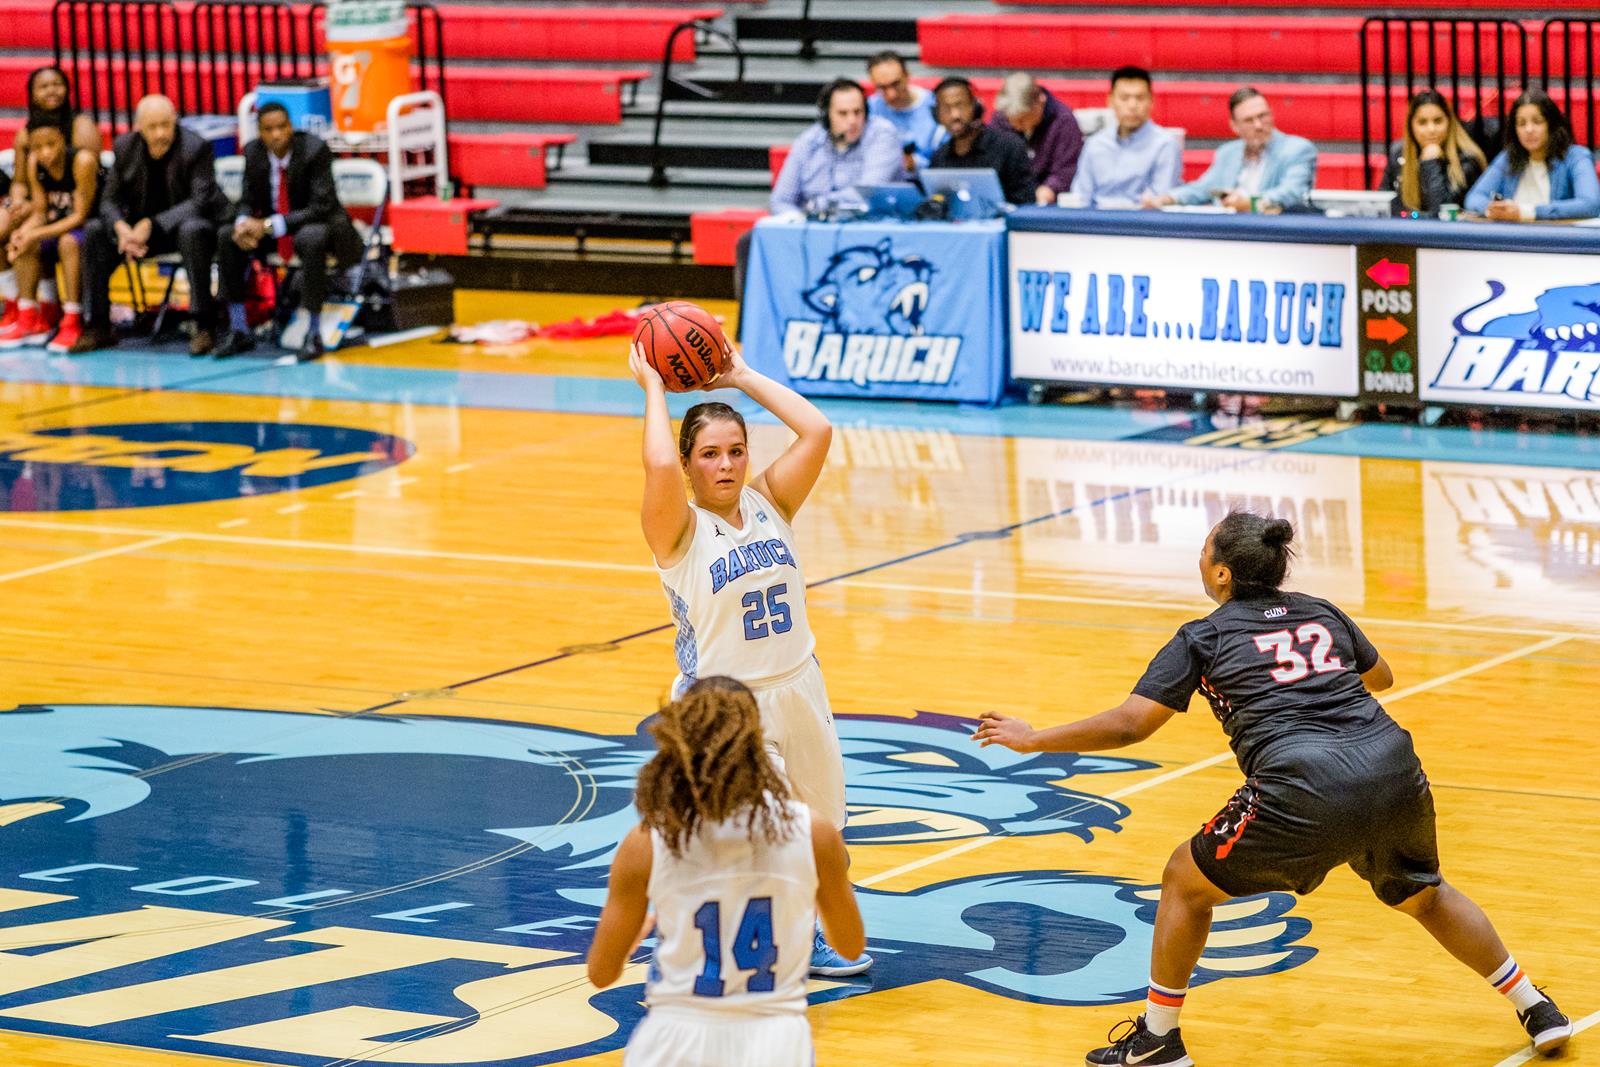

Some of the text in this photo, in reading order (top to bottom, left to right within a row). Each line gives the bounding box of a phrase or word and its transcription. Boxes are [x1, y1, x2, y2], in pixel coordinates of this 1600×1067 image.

[1018, 270, 1070, 333] WE
[1361, 289, 1413, 314] POSS
[667, 353, 697, 388] NCAA
[685, 326, 716, 381] Wilson
[783, 319, 963, 386] BARUCH
[1050, 355, 1315, 386] www.baruchathletics.com
[1429, 334, 1600, 400] BAR
[1363, 371, 1414, 393] BONUS
[742, 583, 792, 640] 25
[1253, 622, 1347, 684] 32
[693, 897, 778, 997] 14
